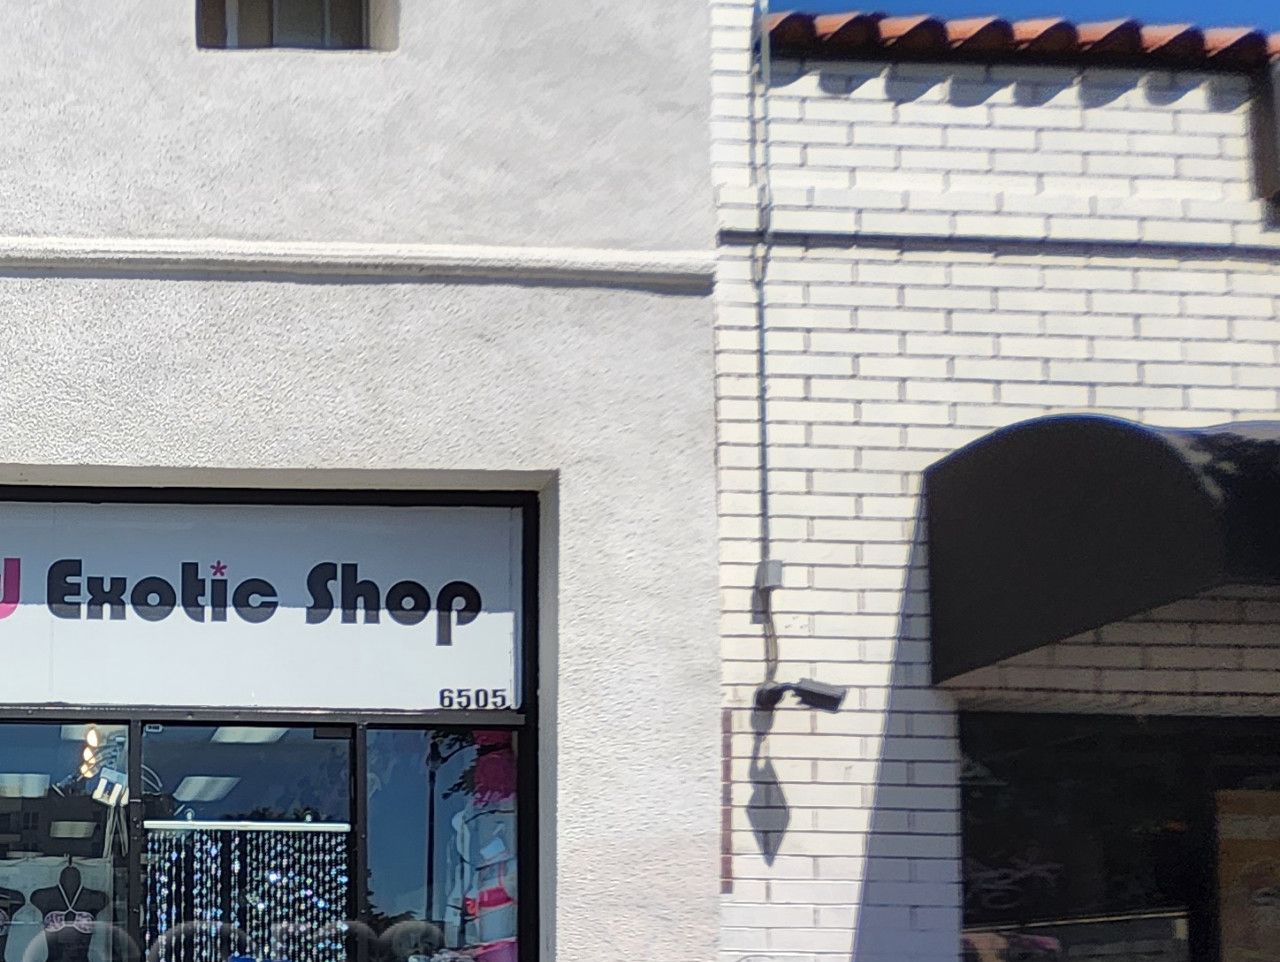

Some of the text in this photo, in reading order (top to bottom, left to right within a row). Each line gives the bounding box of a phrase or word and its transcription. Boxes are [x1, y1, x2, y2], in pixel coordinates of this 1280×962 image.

[46, 558, 279, 624] Exotic
[305, 561, 483, 647] Shop
[438, 687, 509, 710] 6505
